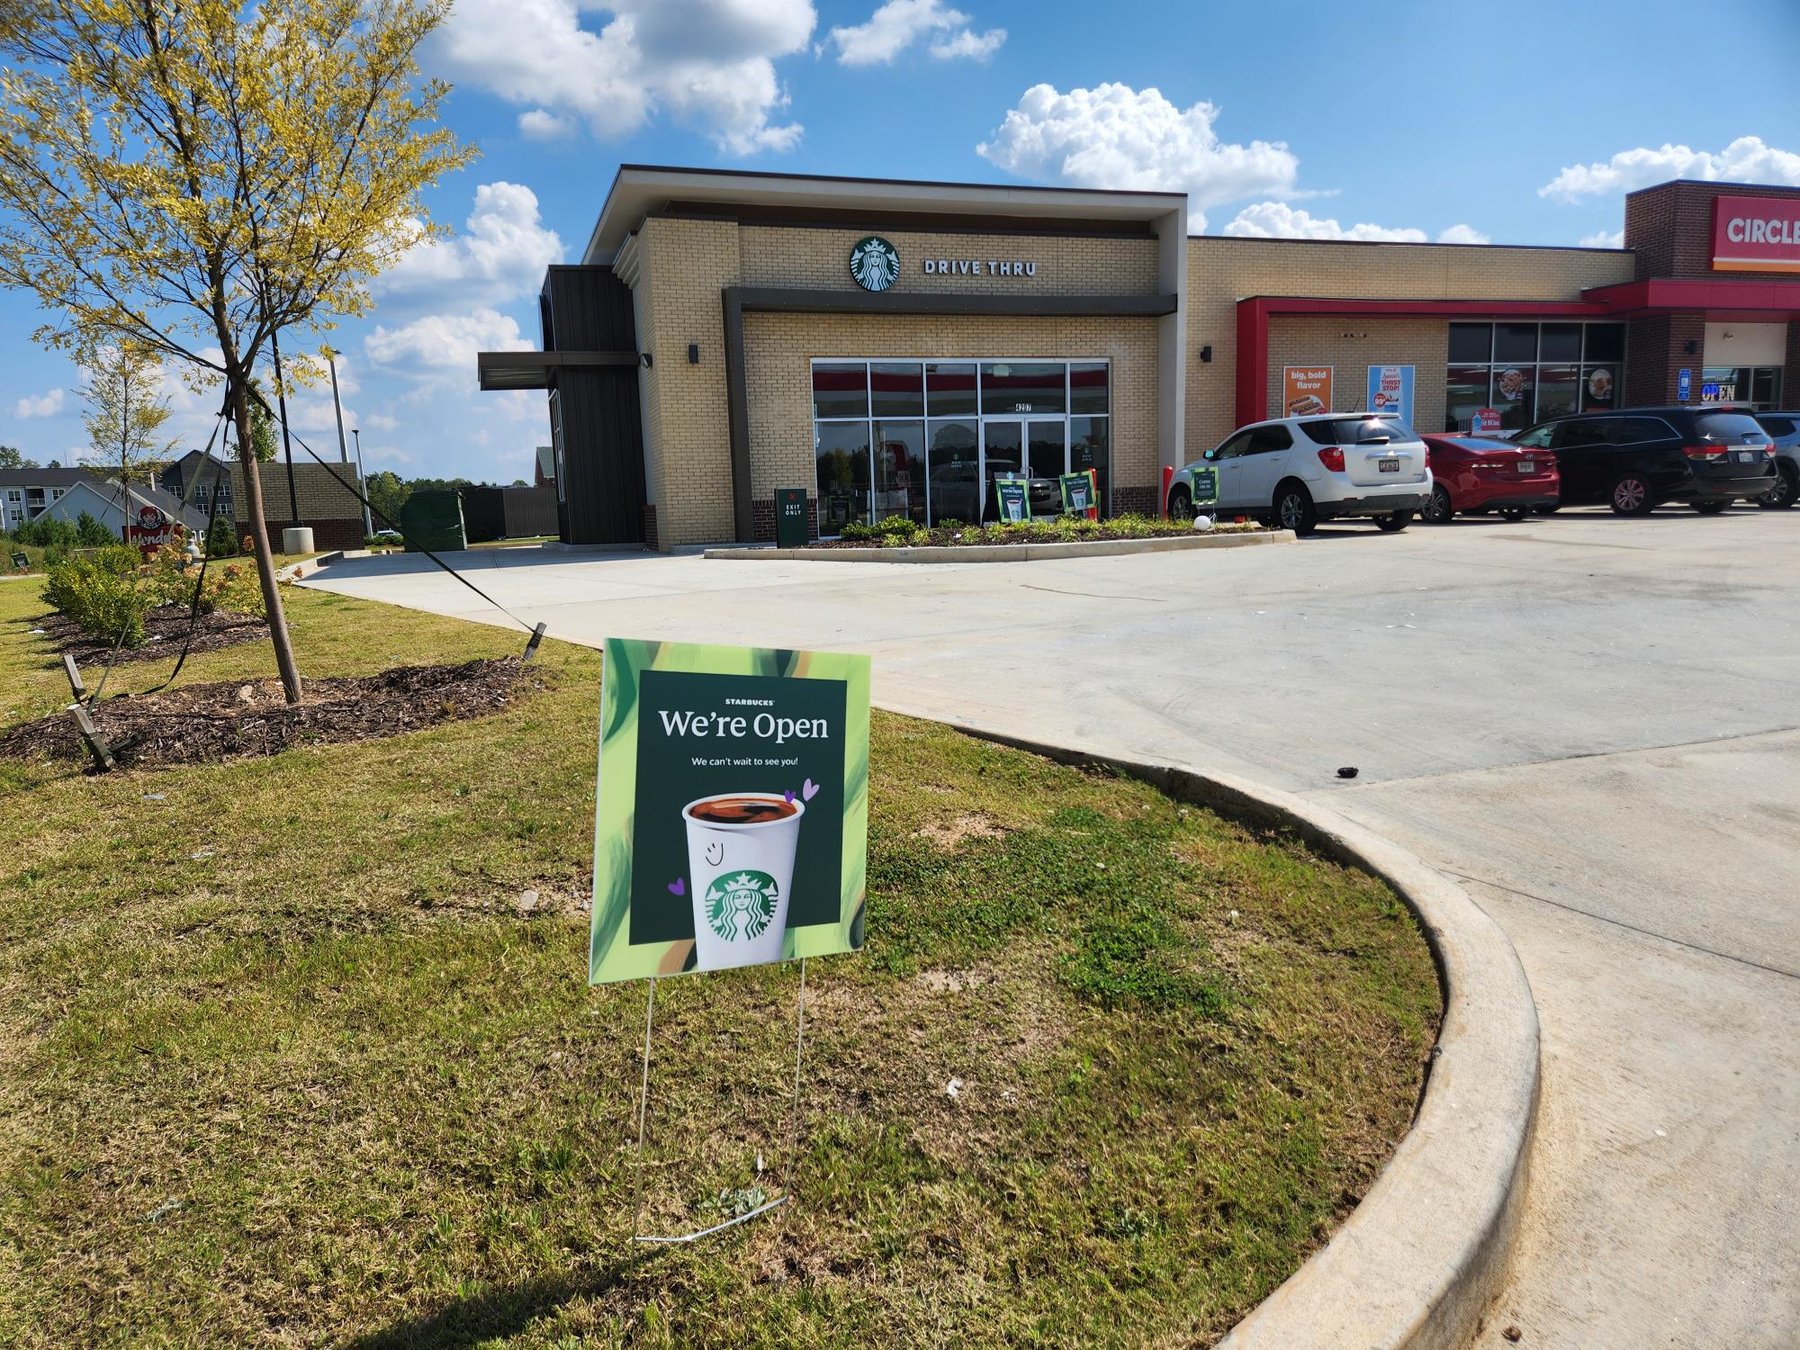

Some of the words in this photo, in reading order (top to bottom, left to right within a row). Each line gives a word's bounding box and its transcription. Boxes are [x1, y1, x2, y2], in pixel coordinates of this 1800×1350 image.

[1727, 217, 1800, 245] CIRCLE
[924, 259, 980, 275] DRIVE
[987, 260, 1036, 277] THRU
[1308, 371, 1327, 379] bold
[1297, 381, 1321, 389] flavor
[1702, 384, 1736, 401] OPEN
[725, 698, 774, 707] STARBUCKS
[753, 712, 829, 744] Open
[692, 757, 707, 766] We
[709, 757, 731, 766] can't
[733, 758, 752, 766] wait
[754, 758, 763, 766] to
[781, 757, 798, 767] you!
